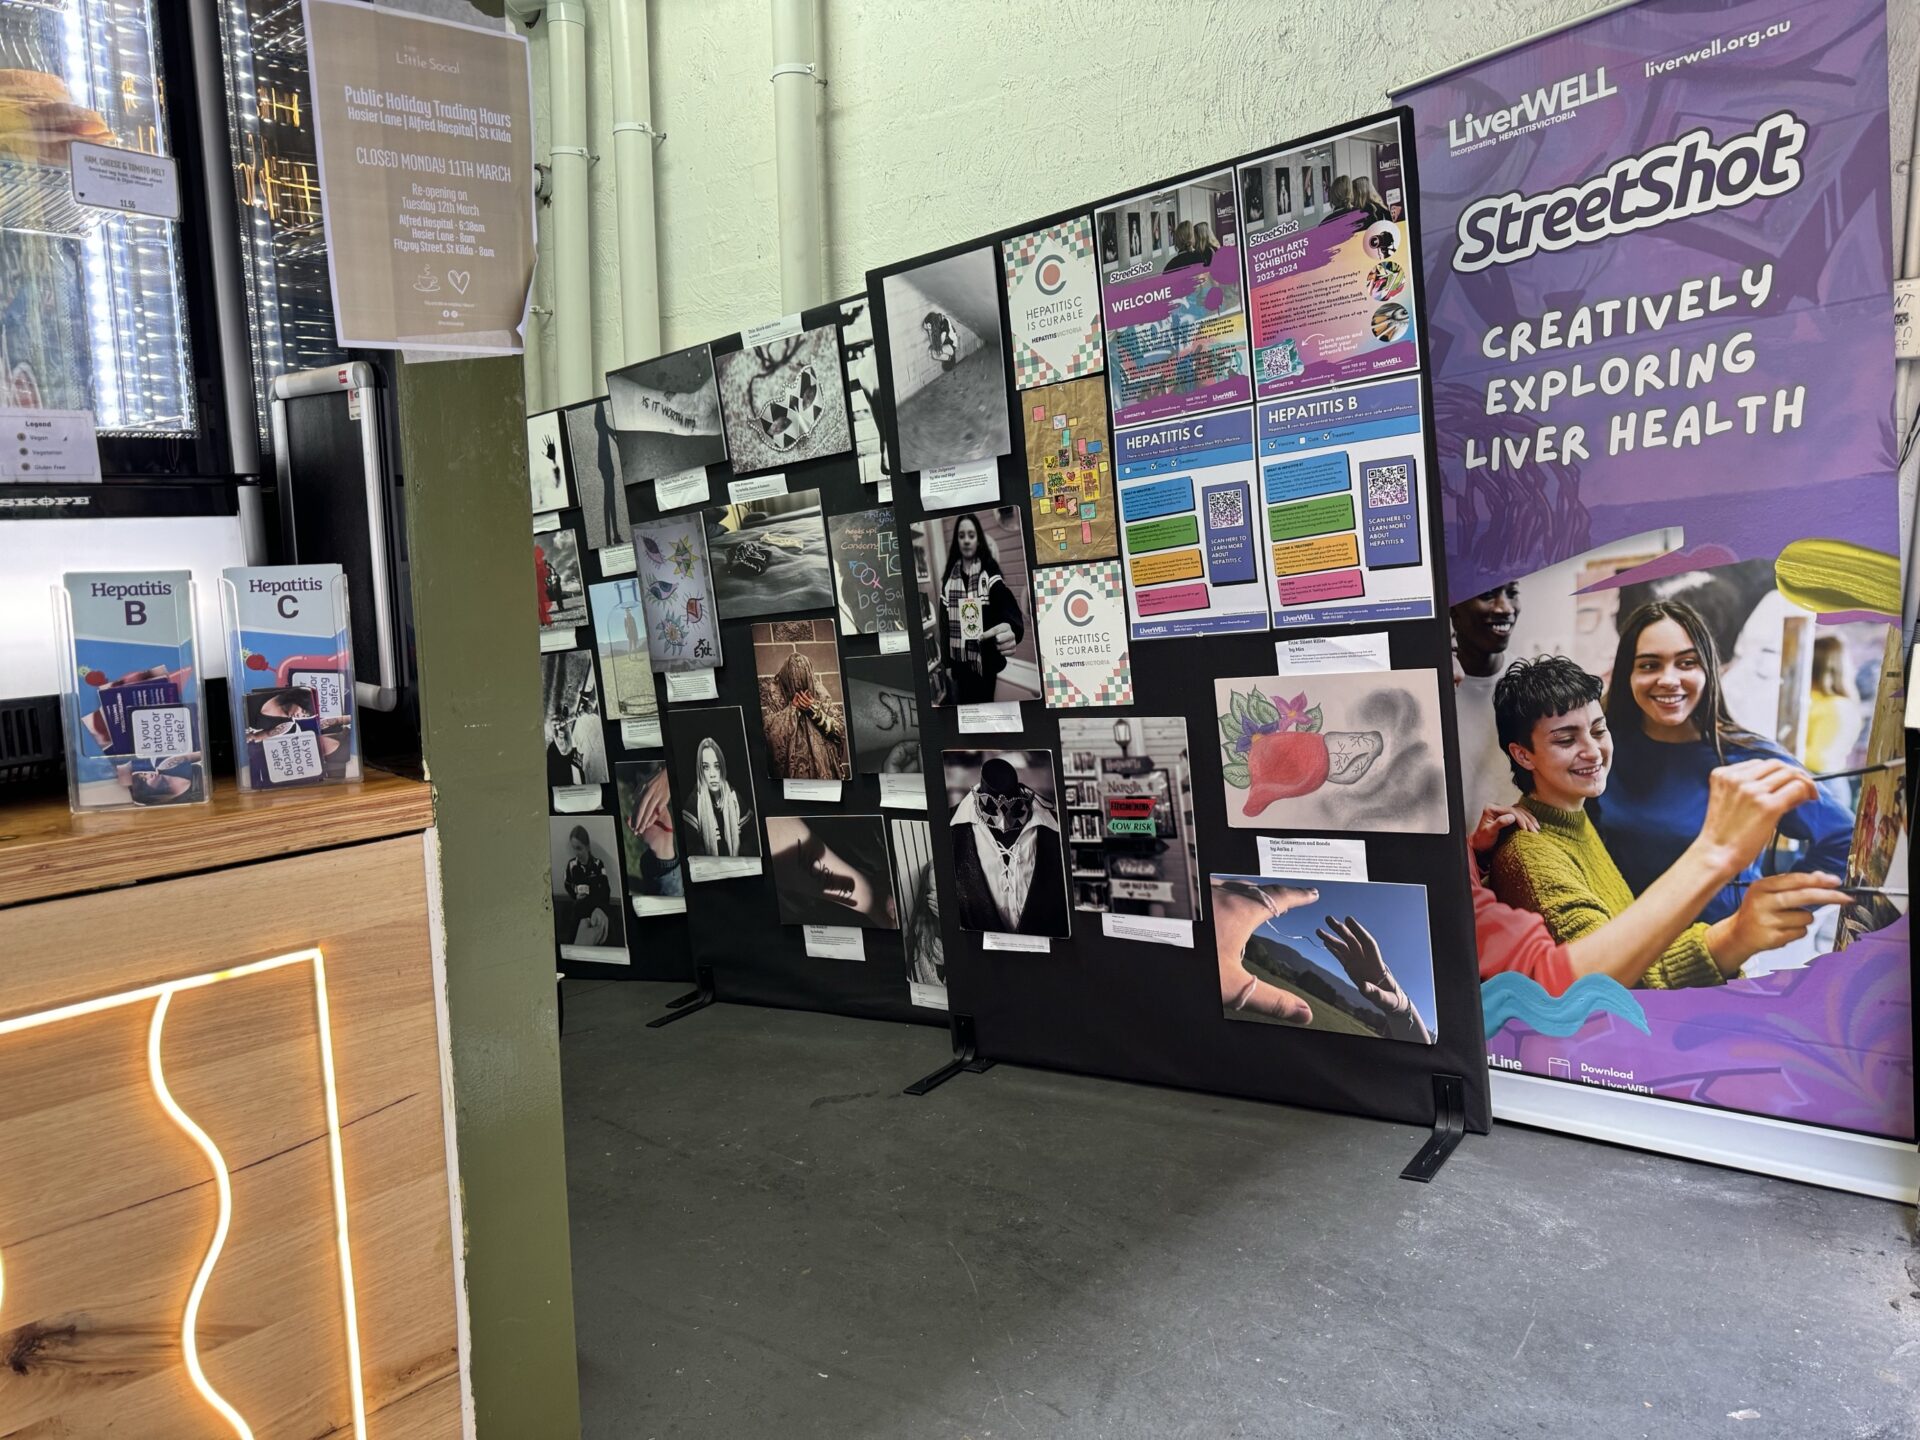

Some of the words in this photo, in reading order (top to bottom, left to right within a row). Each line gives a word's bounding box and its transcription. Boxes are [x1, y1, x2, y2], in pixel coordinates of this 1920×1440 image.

[1645, 20, 1791, 77] liverwell.org.au
[396, 52, 427, 68] Little
[429, 57, 460, 74] Social
[345, 85, 384, 108] Public
[386, 92, 431, 119] Holiday
[433, 100, 477, 125] Trading
[480, 108, 511, 127] Hours
[1449, 67, 1617, 148] LiverWELL
[348, 106, 378, 123] Hosier
[380, 111, 402, 126] Lane
[409, 117, 436, 132] Alfred
[438, 122, 473, 138] Hospital
[480, 127, 489, 140] St
[491, 129, 512, 143] Kilda
[1499, 110, 1576, 142] HEPATITISVICTORIA
[100, 158, 121, 169] CHEESE
[128, 163, 150, 174] TOMATO
[151, 168, 165, 176] MELT
[357, 147, 398, 168] CLOSED
[401, 153, 445, 174] MONDAY
[449, 160, 474, 178] 11TH
[477, 163, 511, 182] MARCH
[412, 183, 456, 200] Re-opening
[458, 191, 467, 201] on
[1461, 124, 1795, 263] StreetShot
[402, 196, 436, 214] Tuesday
[438, 201, 455, 214] 12th
[456, 204, 479, 216] March
[399, 214, 422, 227] Alfred
[423, 217, 453, 230] Hospital
[412, 228, 435, 240] Hosier
[437, 231, 454, 241] Lane
[1250, 221, 1298, 246] StreetShot
[394, 238, 420, 253] Fitzroy
[446, 244, 454, 253] St
[456, 244, 473, 255] Kilda
[1253, 244, 1284, 263] YOUTH
[1287, 238, 1309, 252] ARTS
[1255, 248, 1306, 272] EXHIBITION
[1110, 262, 1152, 283] StreetShot
[1256, 263, 1297, 283] 2023-2024
[1026, 299, 1072, 320] HEPATITIS
[1074, 296, 1082, 307] C
[1112, 287, 1172, 313] WELCOME
[1028, 322, 1035, 331] IS
[1039, 309, 1083, 327] CURABLE
[1482, 263, 1773, 361] CREATIVELY
[1341, 340, 1352, 348] your
[1373, 357, 1402, 368] LiverWELL
[1486, 332, 1756, 416] EXPLORING
[1213, 391, 1238, 400] LiverWELL
[641, 396, 650, 409] IS
[652, 401, 660, 412] IT
[661, 404, 683, 425] WORTH
[1268, 399, 1344, 424] HEPATITIS
[1348, 396, 1358, 410] B
[1126, 428, 1190, 450] HEPATITIS
[1194, 425, 1203, 438] C
[1465, 425, 1590, 472] LIVER
[1609, 385, 1805, 455] HEALTH
[91, 581, 172, 600] Hepatitis
[249, 577, 323, 593] Hepatitis
[124, 600, 147, 626] B
[277, 595, 299, 619] C
[1283, 614, 1315, 622] LiverWELL
[1055, 633, 1100, 645] HEPATITIS
[1102, 632, 1110, 641] C
[1140, 626, 1167, 634] LiverWELL
[1067, 644, 1111, 655] CURABLE
[320, 677, 330, 713] piercing
[329, 684, 338, 705] safe?
[152, 712, 160, 723] or
[141, 720, 152, 741] your
[154, 726, 162, 752] tattoo
[163, 713, 176, 751] piercing
[174, 720, 185, 743] safe?
[272, 749, 283, 771] safe?
[280, 741, 294, 776] piercing
[291, 736, 302, 766] tattoo
[297, 766, 304, 775] or
[304, 748, 313, 767] your
[1112, 822, 1131, 831] LOW
[1134, 823, 1152, 831] RISK
[1581, 1063, 1633, 1080] Download
